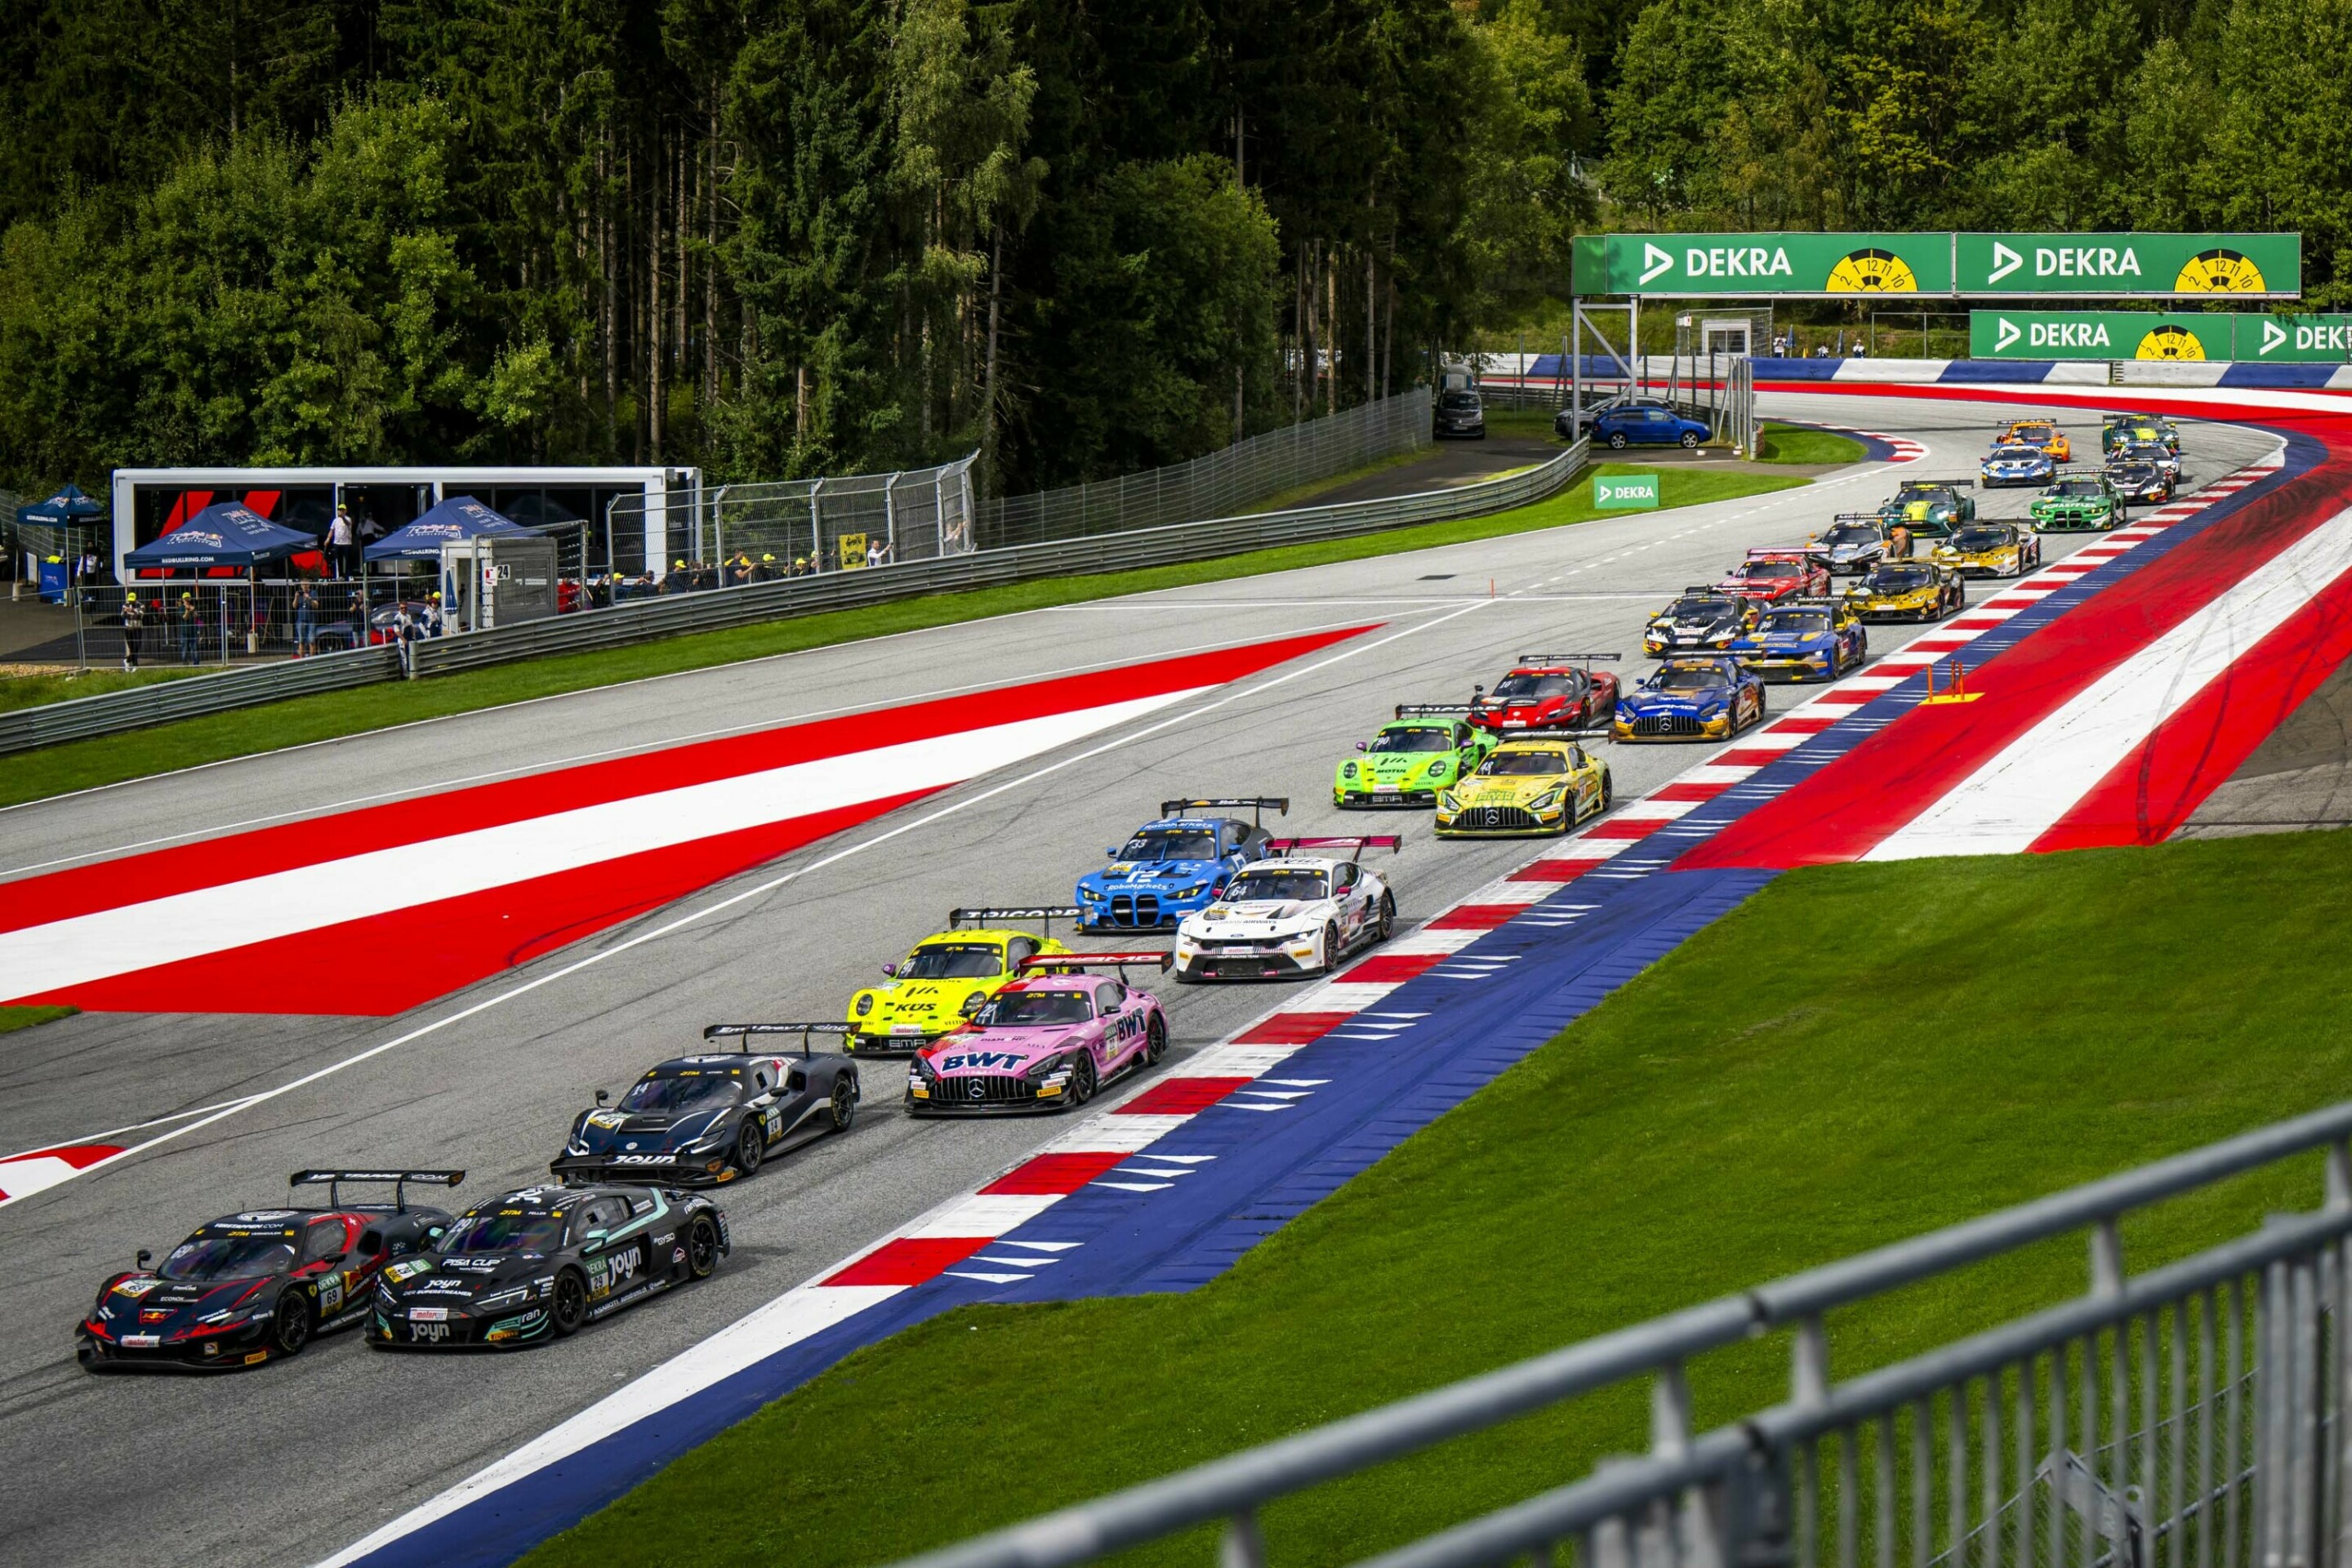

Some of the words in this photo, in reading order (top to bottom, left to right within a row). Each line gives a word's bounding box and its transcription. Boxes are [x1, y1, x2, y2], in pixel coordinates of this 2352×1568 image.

[1686, 247, 1793, 277] DEKRA
[2036, 247, 2142, 276] DEKRA
[1840, 275, 1852, 287] 2
[1853, 264, 1861, 275] 1
[1866, 260, 1879, 272] 12
[1882, 263, 1893, 275] 11
[1891, 274, 1905, 288] 10
[2188, 276, 2201, 287] 2
[2202, 265, 2210, 276] 1
[2215, 260, 2227, 272] 12
[2230, 263, 2242, 276] 11
[2239, 274, 2254, 289] 10
[2030, 323, 2111, 347] DEKRA
[2146, 346, 2156, 357] 2
[2156, 337, 2163, 347] 1
[2167, 334, 2176, 345] 12
[2178, 336, 2188, 348] 11
[2185, 346, 2196, 359] 10
[1615, 486, 1655, 499] DEKRA
[497, 565, 510, 579] 24
[1499, 680, 1512, 688] 10
[1377, 736, 1390, 746] 90
[1144, 822, 1214, 830] RoboMarkets
[1132, 840, 1147, 849] 33
[1232, 885, 1248, 896] 64
[894, 1003, 938, 1012] KÜS
[719, 1025, 756, 1033] Eml
[1116, 1006, 1147, 1044] BWT
[1109, 1038, 1116, 1050] 22
[941, 1052, 1027, 1072] BWT
[631, 1084, 649, 1096] 14
[770, 1119, 778, 1132] 14
[449, 1218, 473, 1233] 29
[170, 1244, 194, 1259] 69
[443, 1258, 470, 1267] PISA
[318, 1273, 341, 1291] DEKRA
[594, 1276, 604, 1290] 29
[327, 1289, 337, 1304] 69
[522, 1308, 541, 1323] ran
